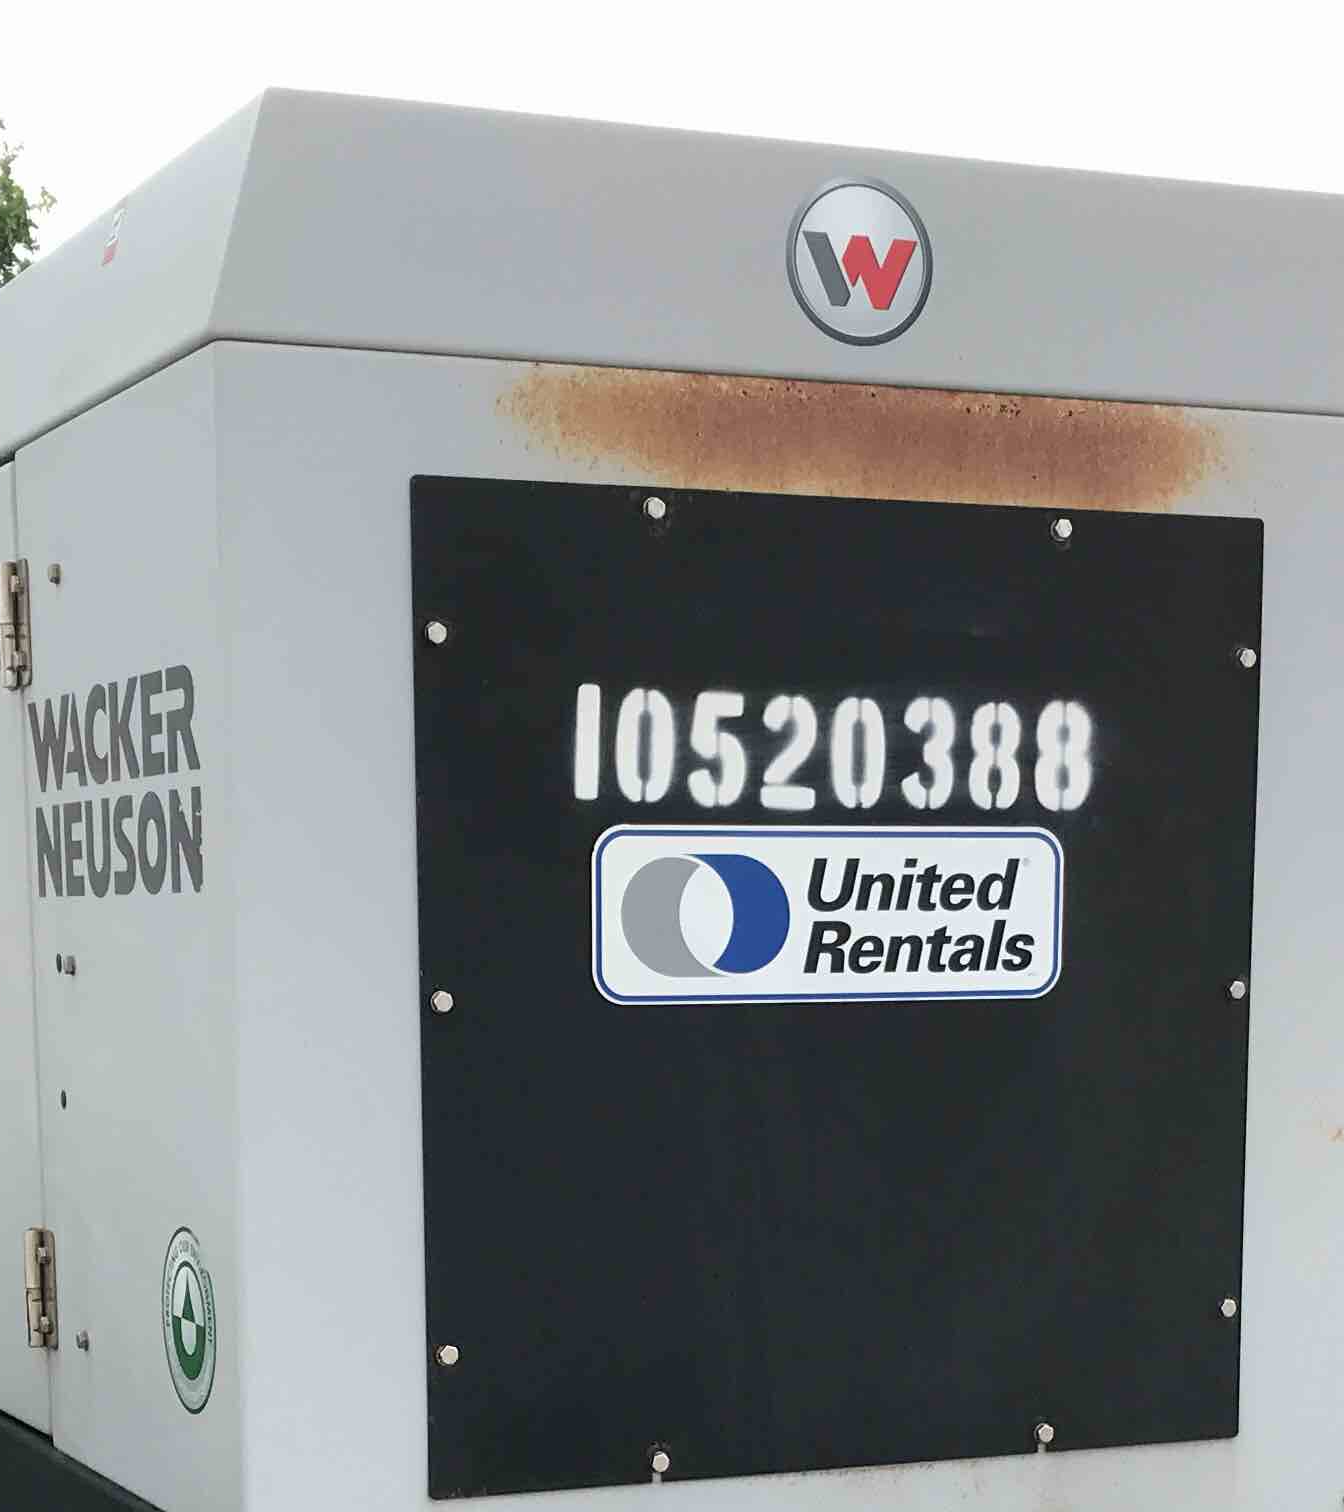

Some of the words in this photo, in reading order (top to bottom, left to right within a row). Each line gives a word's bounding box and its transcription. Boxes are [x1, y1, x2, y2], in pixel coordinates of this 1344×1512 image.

[803, 230, 917, 310] W
[27, 664, 201, 793] WACKER
[574, 683, 1093, 812] 10520388
[35, 786, 203, 898] NEUSON
[807, 858, 1018, 912] United
[803, 920, 1035, 974] Rentals
